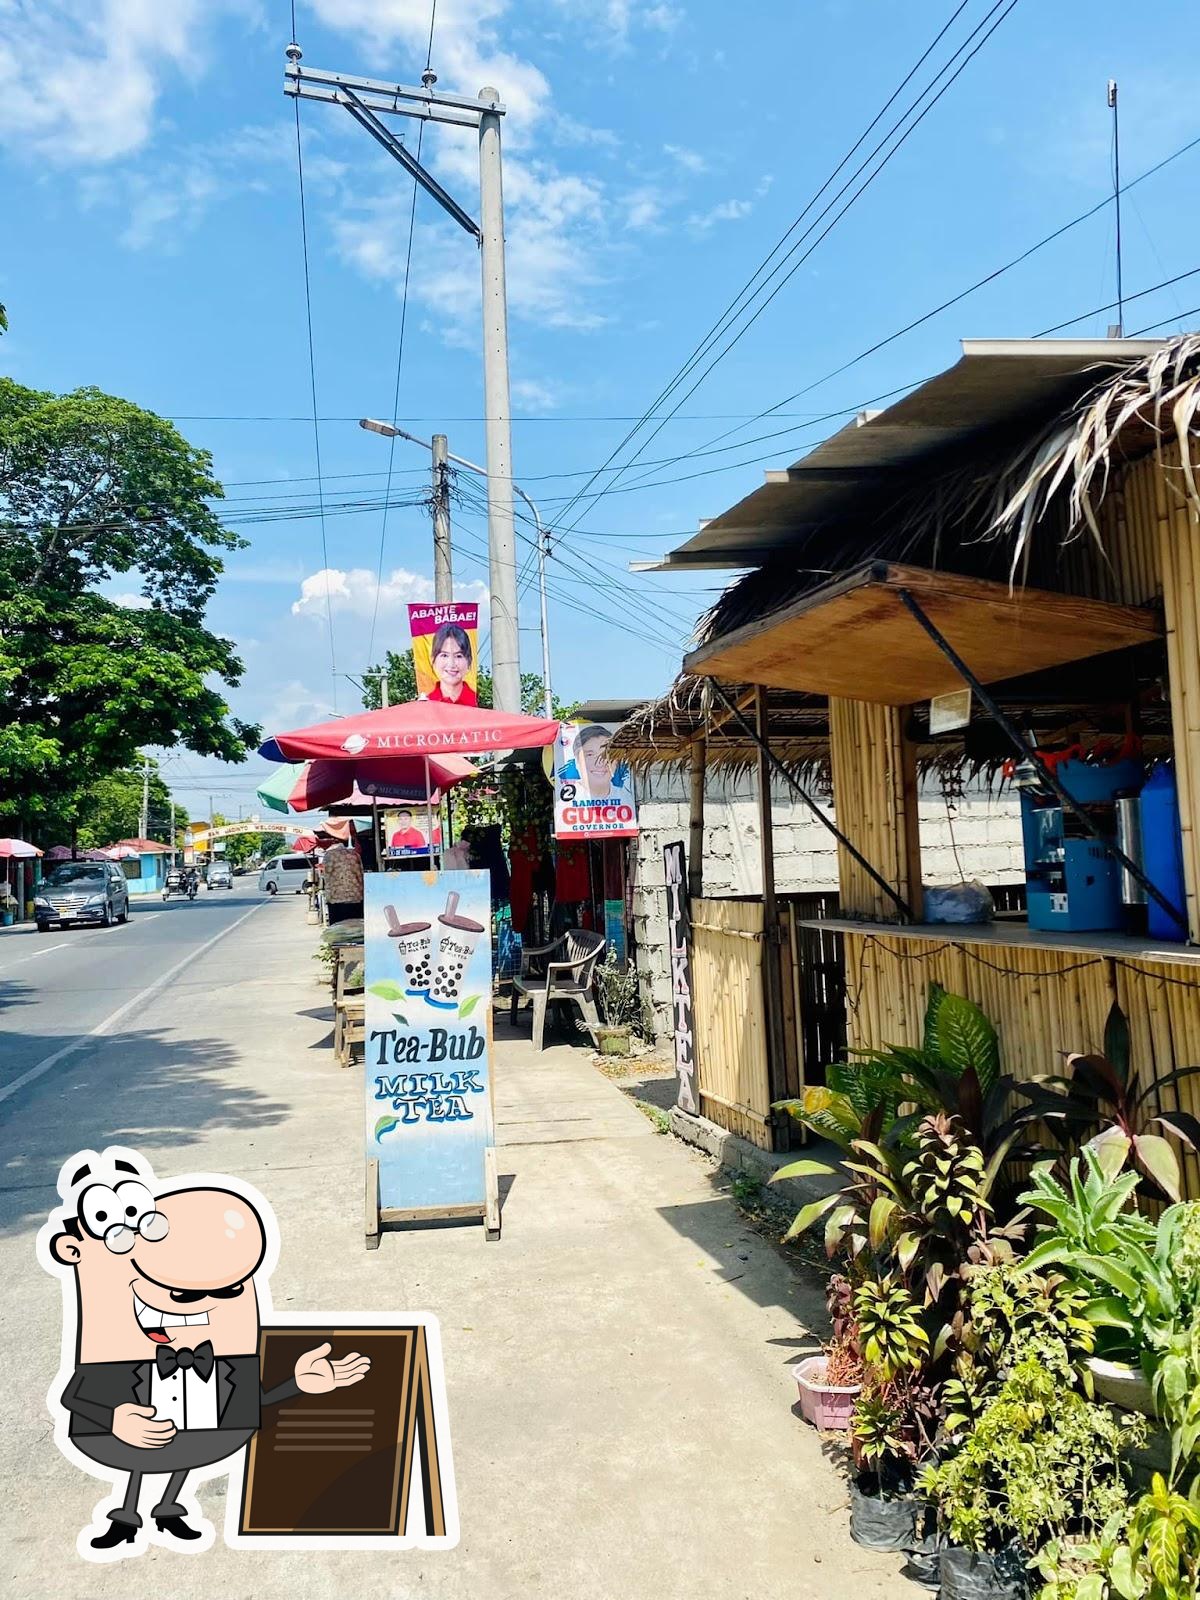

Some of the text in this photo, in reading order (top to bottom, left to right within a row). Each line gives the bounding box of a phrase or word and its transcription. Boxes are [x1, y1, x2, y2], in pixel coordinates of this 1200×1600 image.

[411, 605, 457, 620] ABANTE
[435, 611, 477, 625] BABAE!
[377, 729, 503, 749] MICROMATIC
[572, 799, 609, 808] RAMON
[562, 805, 633, 825] GUICO
[255, 824, 288, 832] WELCOMES
[572, 823, 625, 831] GOVERNOR
[370, 1025, 486, 1065] Tea-Bub
[374, 1069, 485, 1100] MILK
[392, 1095, 474, 1124] TEA
